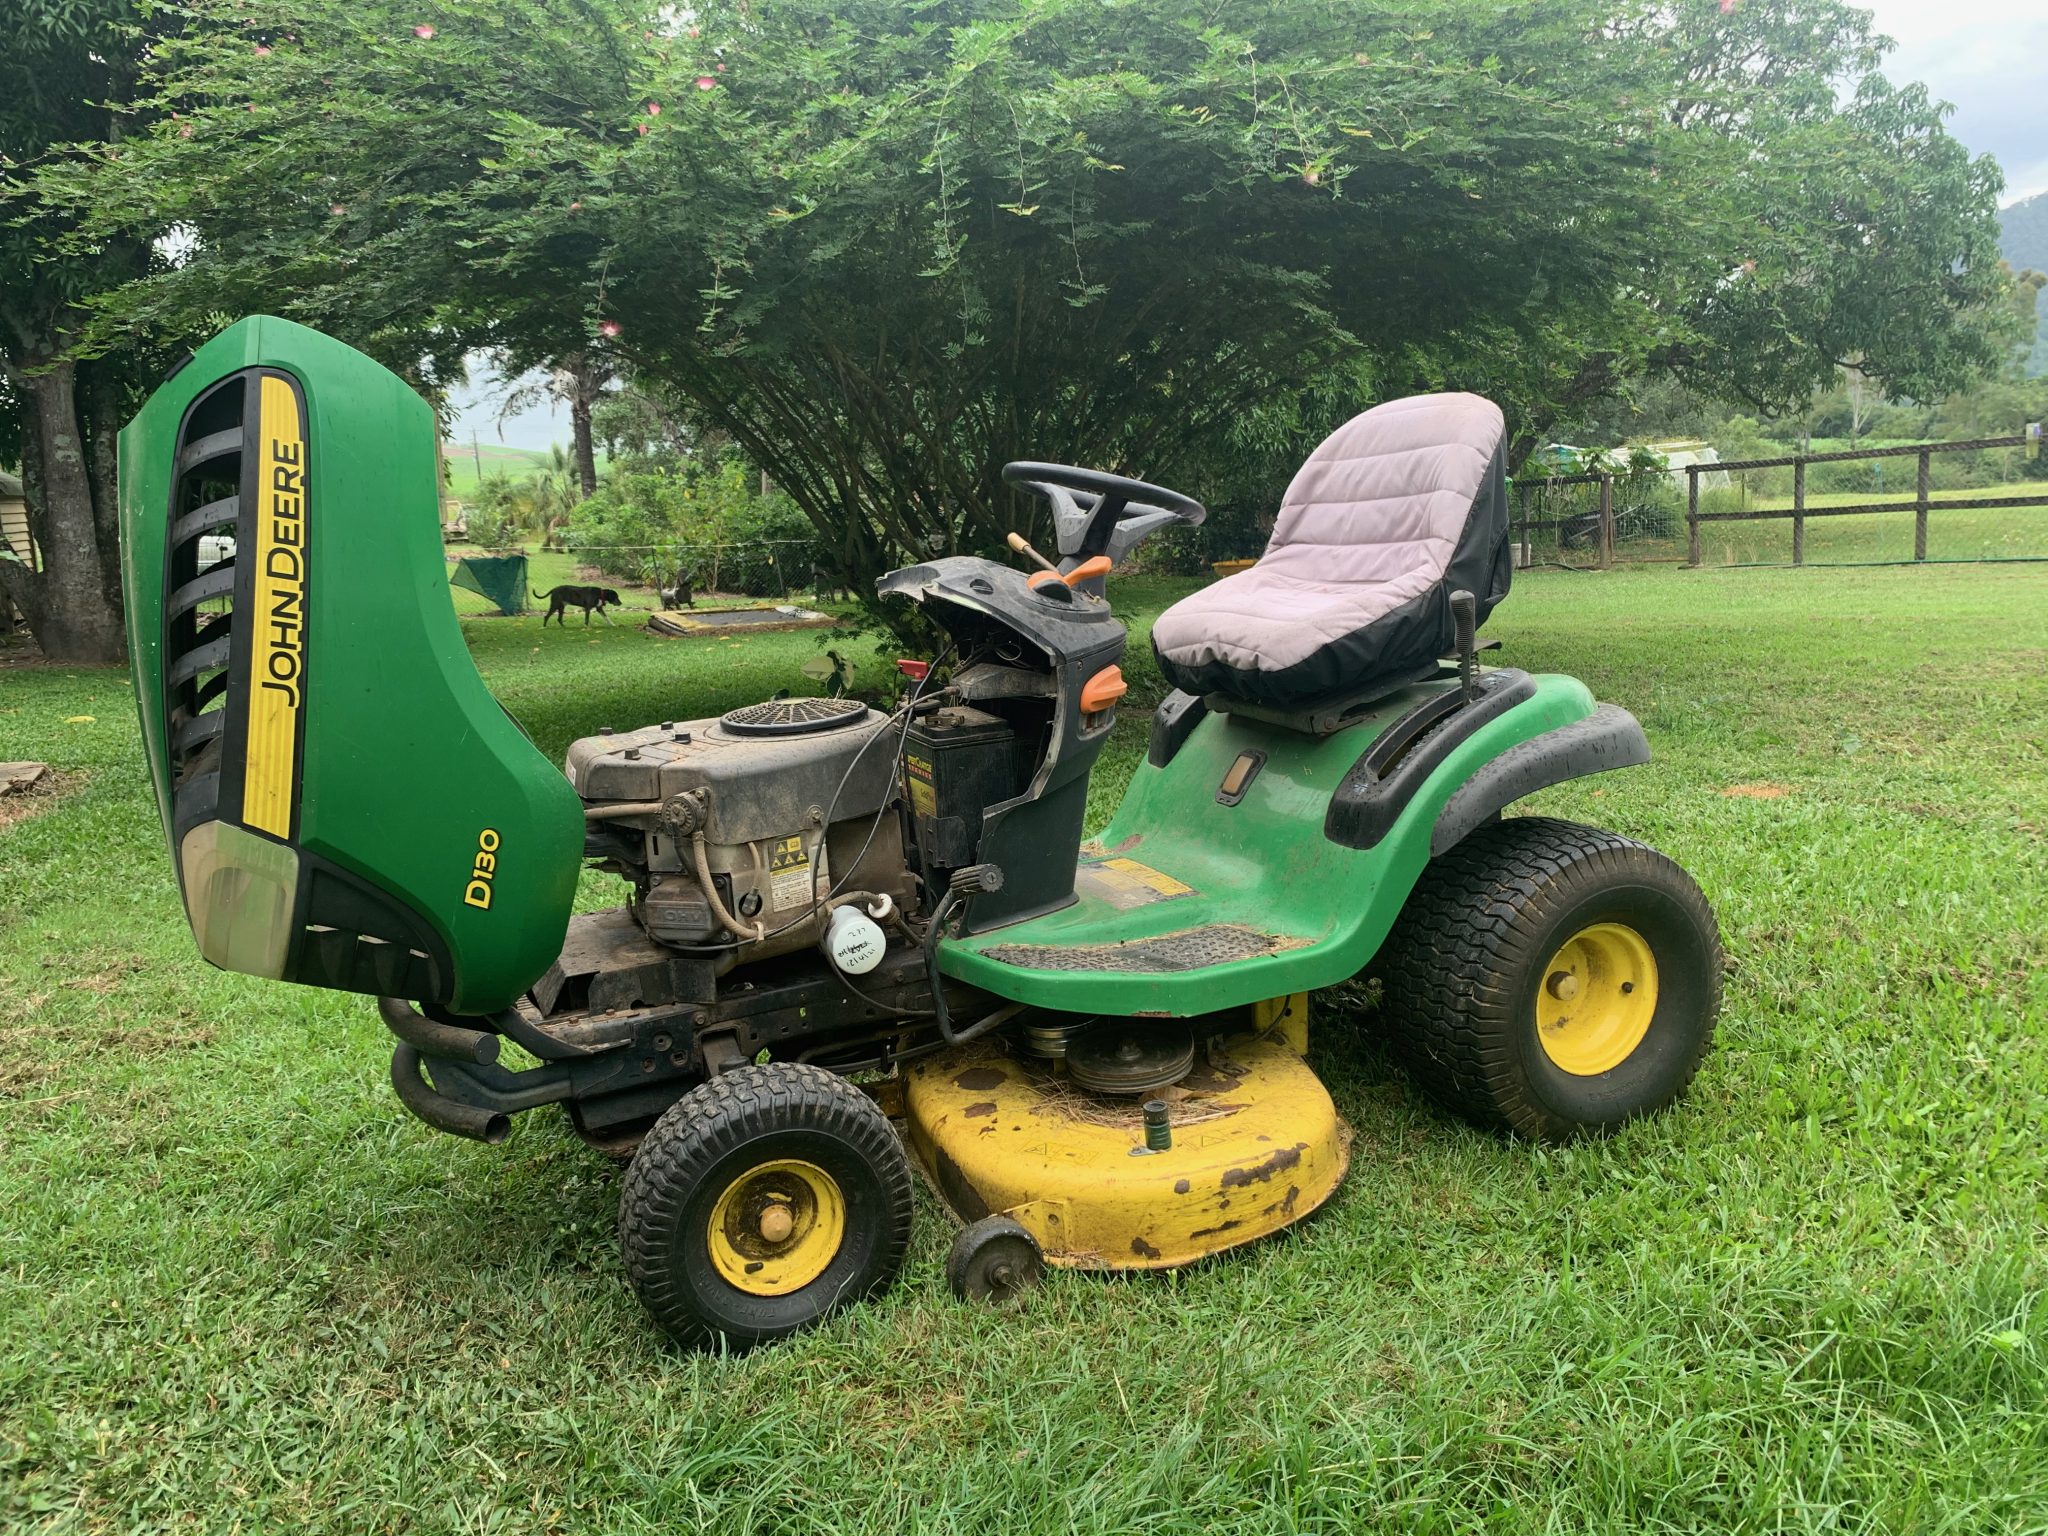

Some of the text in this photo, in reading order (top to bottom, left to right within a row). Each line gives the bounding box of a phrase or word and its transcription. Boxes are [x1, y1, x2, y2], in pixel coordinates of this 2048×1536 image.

[261, 438, 304, 708] JOHN DEERE
[463, 827, 501, 910] D130
